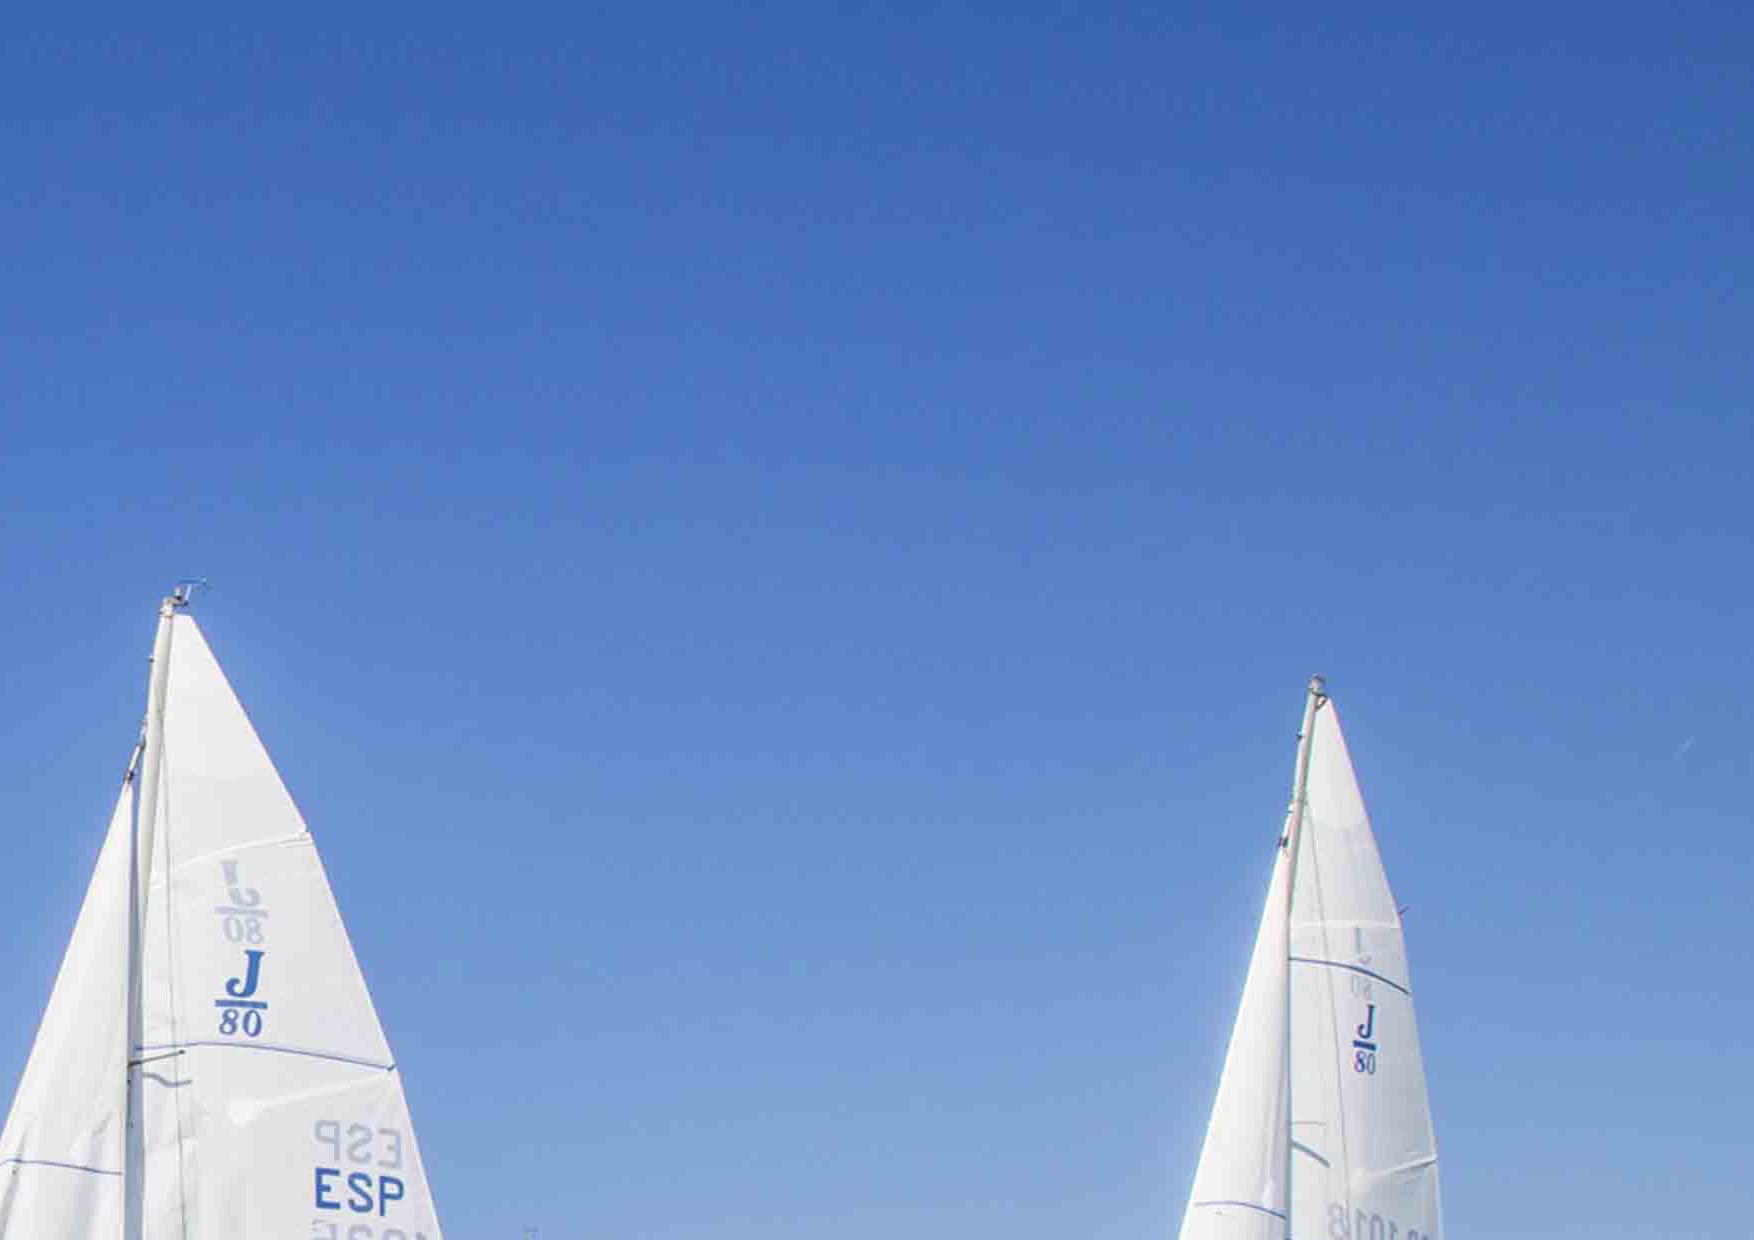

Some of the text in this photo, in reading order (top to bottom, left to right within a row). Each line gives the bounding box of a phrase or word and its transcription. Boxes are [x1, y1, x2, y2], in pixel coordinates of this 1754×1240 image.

[225, 949, 265, 998] J
[219, 1008, 263, 1037] 80
[1357, 1004, 1375, 1039] J
[1354, 1050, 1376, 1074] 80
[314, 1167, 406, 1217] ESP
